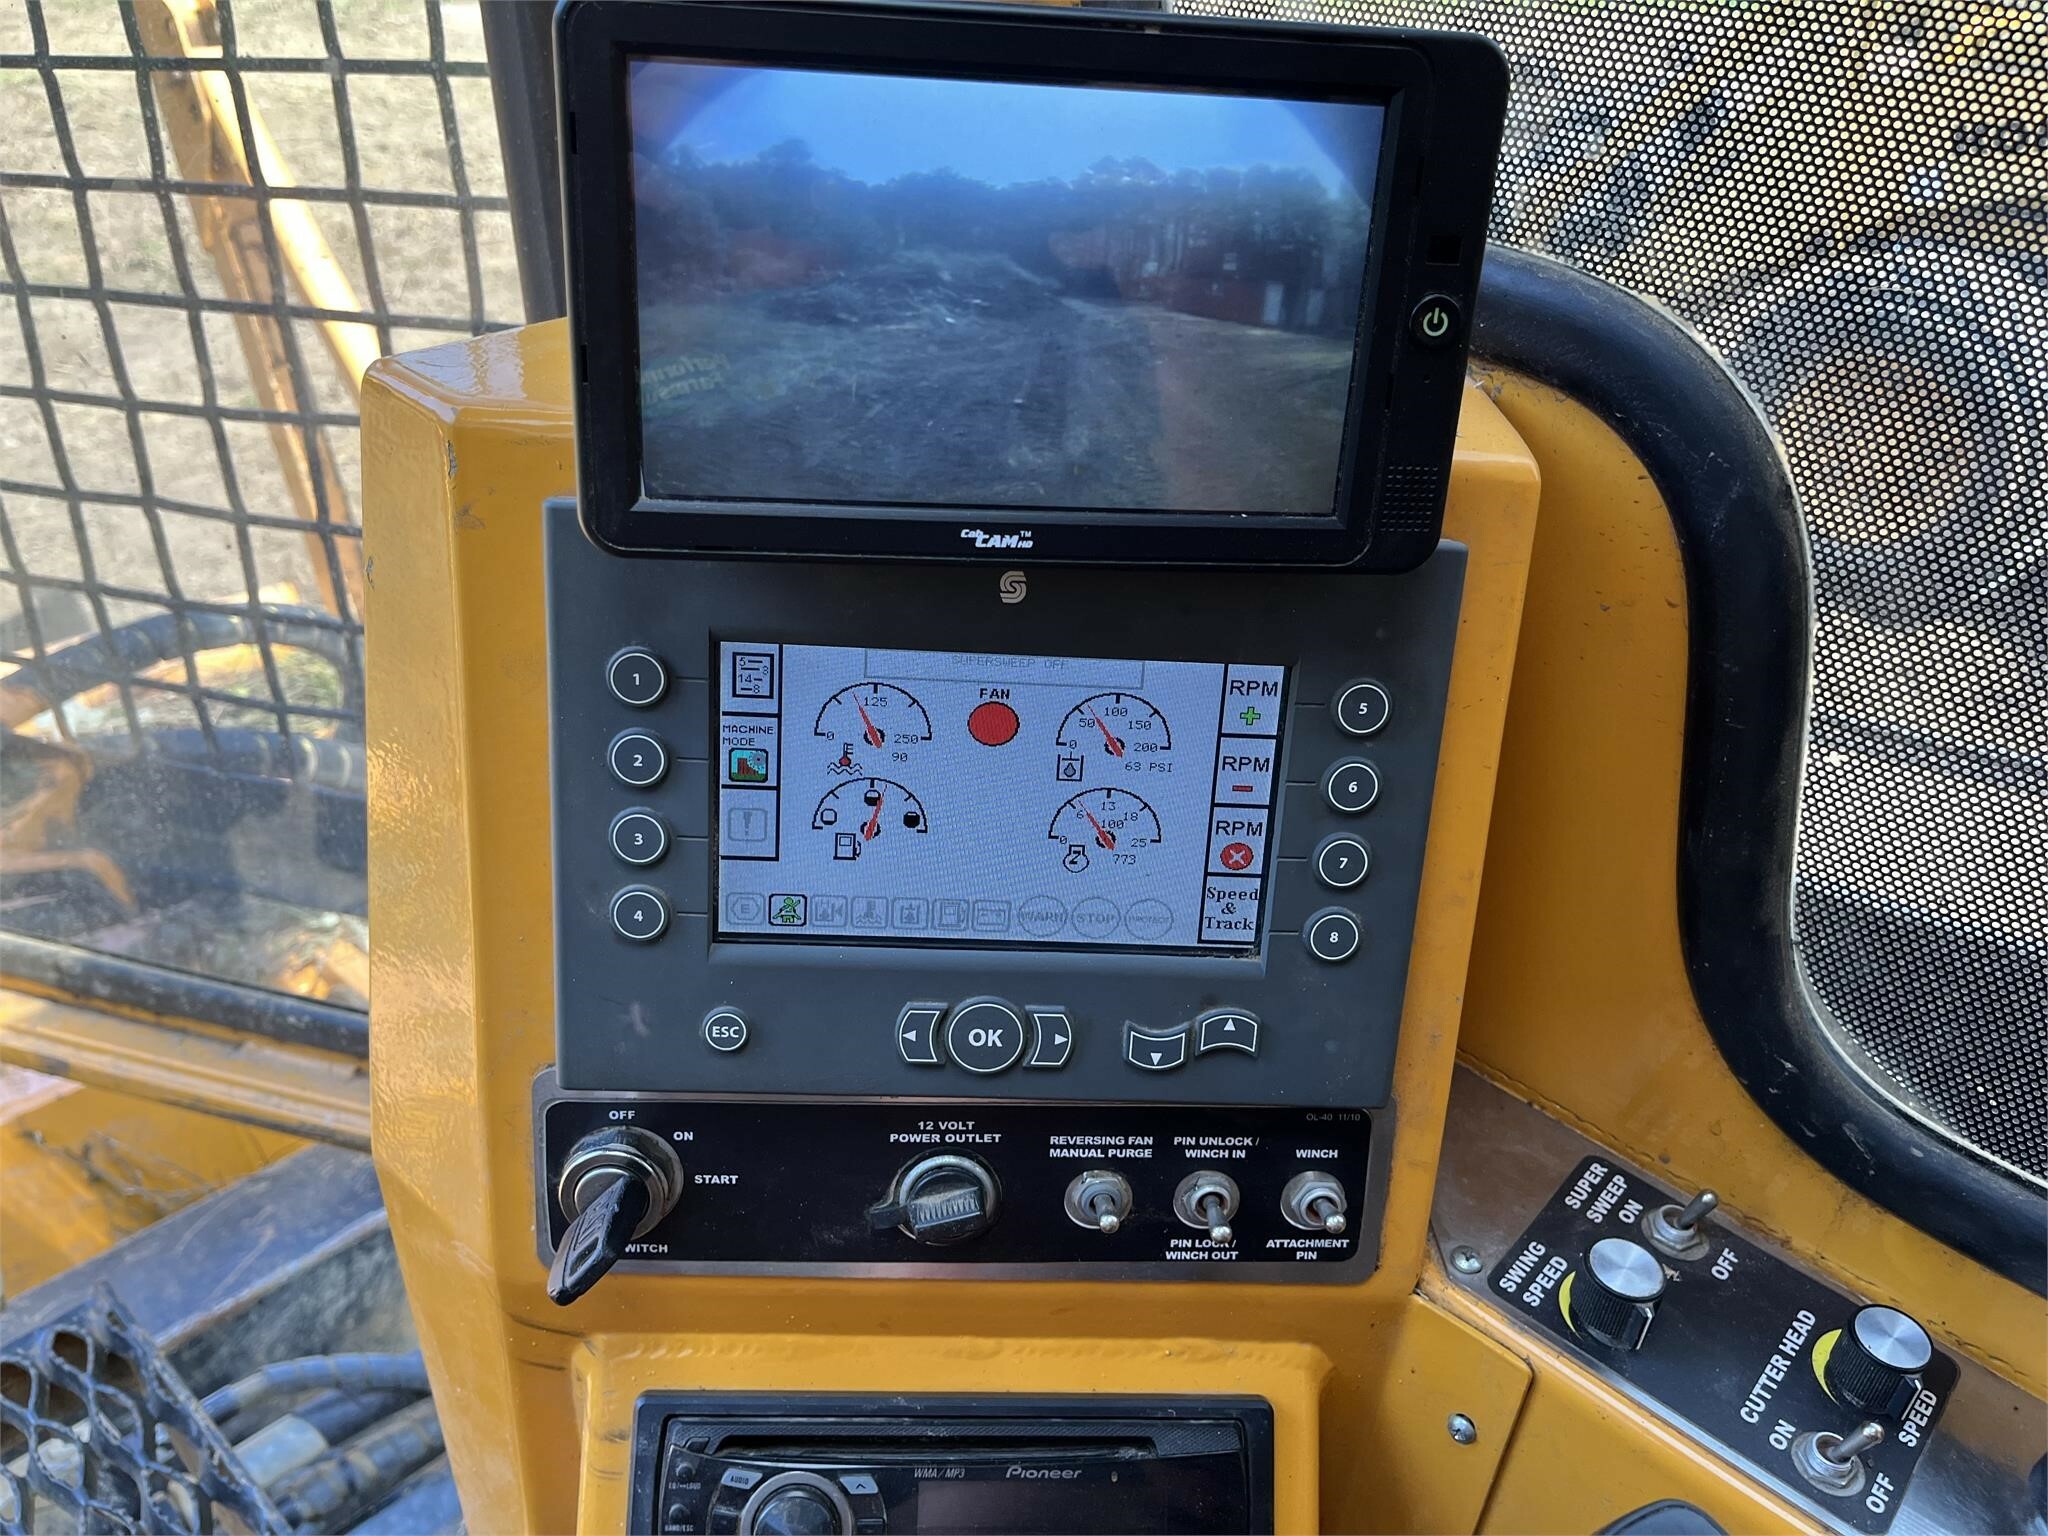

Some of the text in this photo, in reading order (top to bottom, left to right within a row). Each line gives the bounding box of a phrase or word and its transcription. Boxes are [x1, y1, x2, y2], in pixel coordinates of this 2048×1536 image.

[738, 657, 746, 666] 5
[951, 655, 1069, 670] SUPERSWEEP OFF
[632, 673, 641, 685] 1
[738, 674, 752, 683] 14
[979, 688, 1010, 699] FAN
[1229, 680, 1279, 697] RPM
[863, 697, 888, 707] 125
[1104, 707, 1128, 717] 100
[1358, 702, 1368, 715] 5
[1079, 718, 1096, 728] 50
[1128, 720, 1152, 730] 150
[722, 725, 774, 735] MACHINE
[722, 736, 755, 746] MODE
[826, 731, 835, 741] 0
[894, 734, 919, 744] 250
[1069, 739, 1078, 749] 0
[1133, 742, 1158, 752] 200
[633, 755, 643, 767] 2
[891, 752, 908, 762] 90
[1149, 762, 1173, 773] PSI
[1221, 756, 1270, 773] RPM
[1348, 781, 1358, 793] 6
[1101, 801, 1116, 811] 13
[1076, 810, 1084, 820] 6
[1124, 812, 1138, 822] 18
[1101, 819, 1125, 829] 100
[1215, 821, 1263, 837] RPM
[634, 833, 644, 845] 3
[1059, 836, 1068, 845] 0
[1131, 838, 1147, 848] 25
[1339, 857, 1348, 869] 7
[1206, 886, 1259, 903] Speed
[1221, 902, 1237, 914] &
[633, 910, 643, 922] 4
[1076, 913, 1116, 924] STOP
[1205, 917, 1254, 930] Track
[1329, 931, 1339, 943] 8
[712, 1026, 739, 1039] ESC
[968, 1028, 1003, 1047] OK
[609, 1110, 636, 1120] OFF
[917, 1121, 975, 1130] 12 VOLT
[673, 1131, 694, 1141] ON
[889, 1133, 1002, 1143] POWER OUTLET
[1049, 1136, 1153, 1146] REVERSING FAN
[1173, 1136, 1197, 1146] PIN
[1199, 1136, 1253, 1146] UNLOCK
[1049, 1149, 1153, 1158] MANUAL PURGE
[1185, 1149, 1246, 1159] WINCH IN
[1295, 1149, 1339, 1159] WINCH
[694, 1174, 739, 1185] START
[1564, 1162, 1608, 1211] SUPER
[1586, 1174, 1629, 1225] SWEEP
[1618, 1199, 1643, 1225] ON
[624, 1243, 669, 1253] WITCH
[1170, 1239, 1193, 1248] PIN
[1266, 1239, 1350, 1249] ATTACHMENT
[1165, 1251, 1239, 1260] WINCH OUT
[1296, 1251, 1318, 1260] PIN
[1499, 1241, 1546, 1294] SWING
[1711, 1248, 1739, 1281] OFF
[1522, 1255, 1568, 1308] SPEED
[1740, 1309, 1817, 1425] CUTTER HEAD
[1898, 1389, 1938, 1448] SPEED
[1768, 1419, 1797, 1452] ON
[1005, 1465, 1083, 1480] Pioneer
[730, 1475, 750, 1486] AUDIO
[1865, 1472, 1895, 1515] OFF
